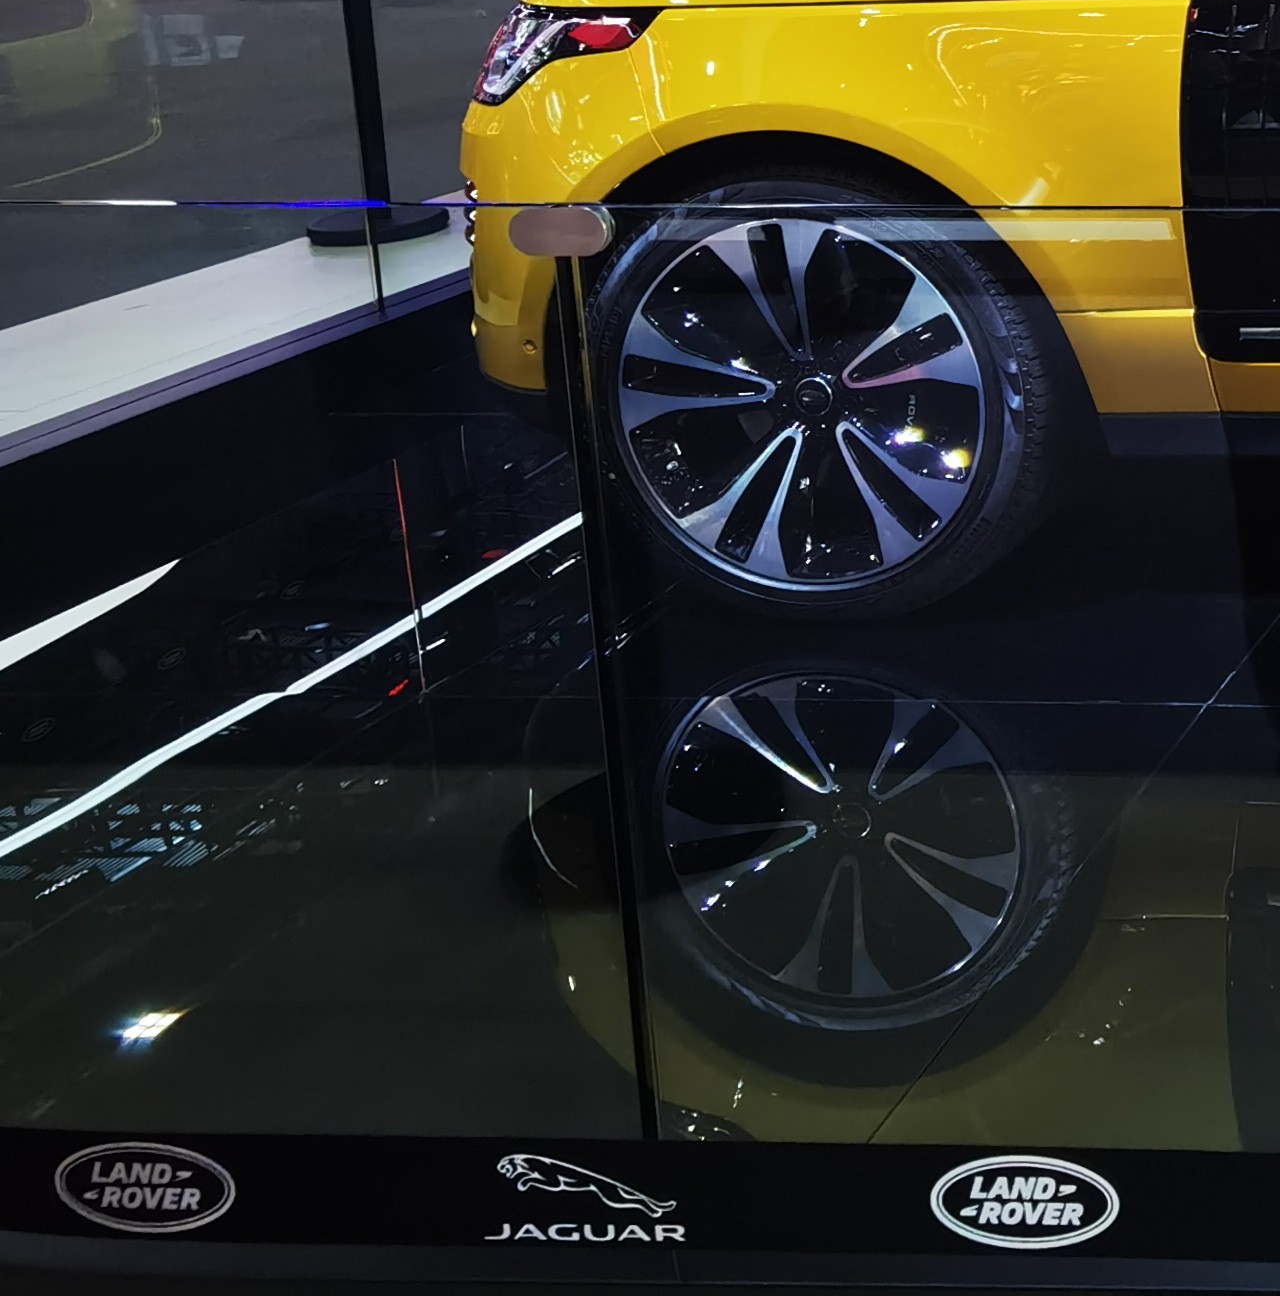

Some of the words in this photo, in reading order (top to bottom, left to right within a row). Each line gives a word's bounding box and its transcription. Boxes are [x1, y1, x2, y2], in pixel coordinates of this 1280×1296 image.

[91, 1161, 173, 1185] LAND
[102, 1187, 201, 1211] ROVER
[969, 1176, 1056, 1200] LAND
[978, 1201, 1084, 1226] ROVER
[484, 1223, 686, 1242] JAGUAR
